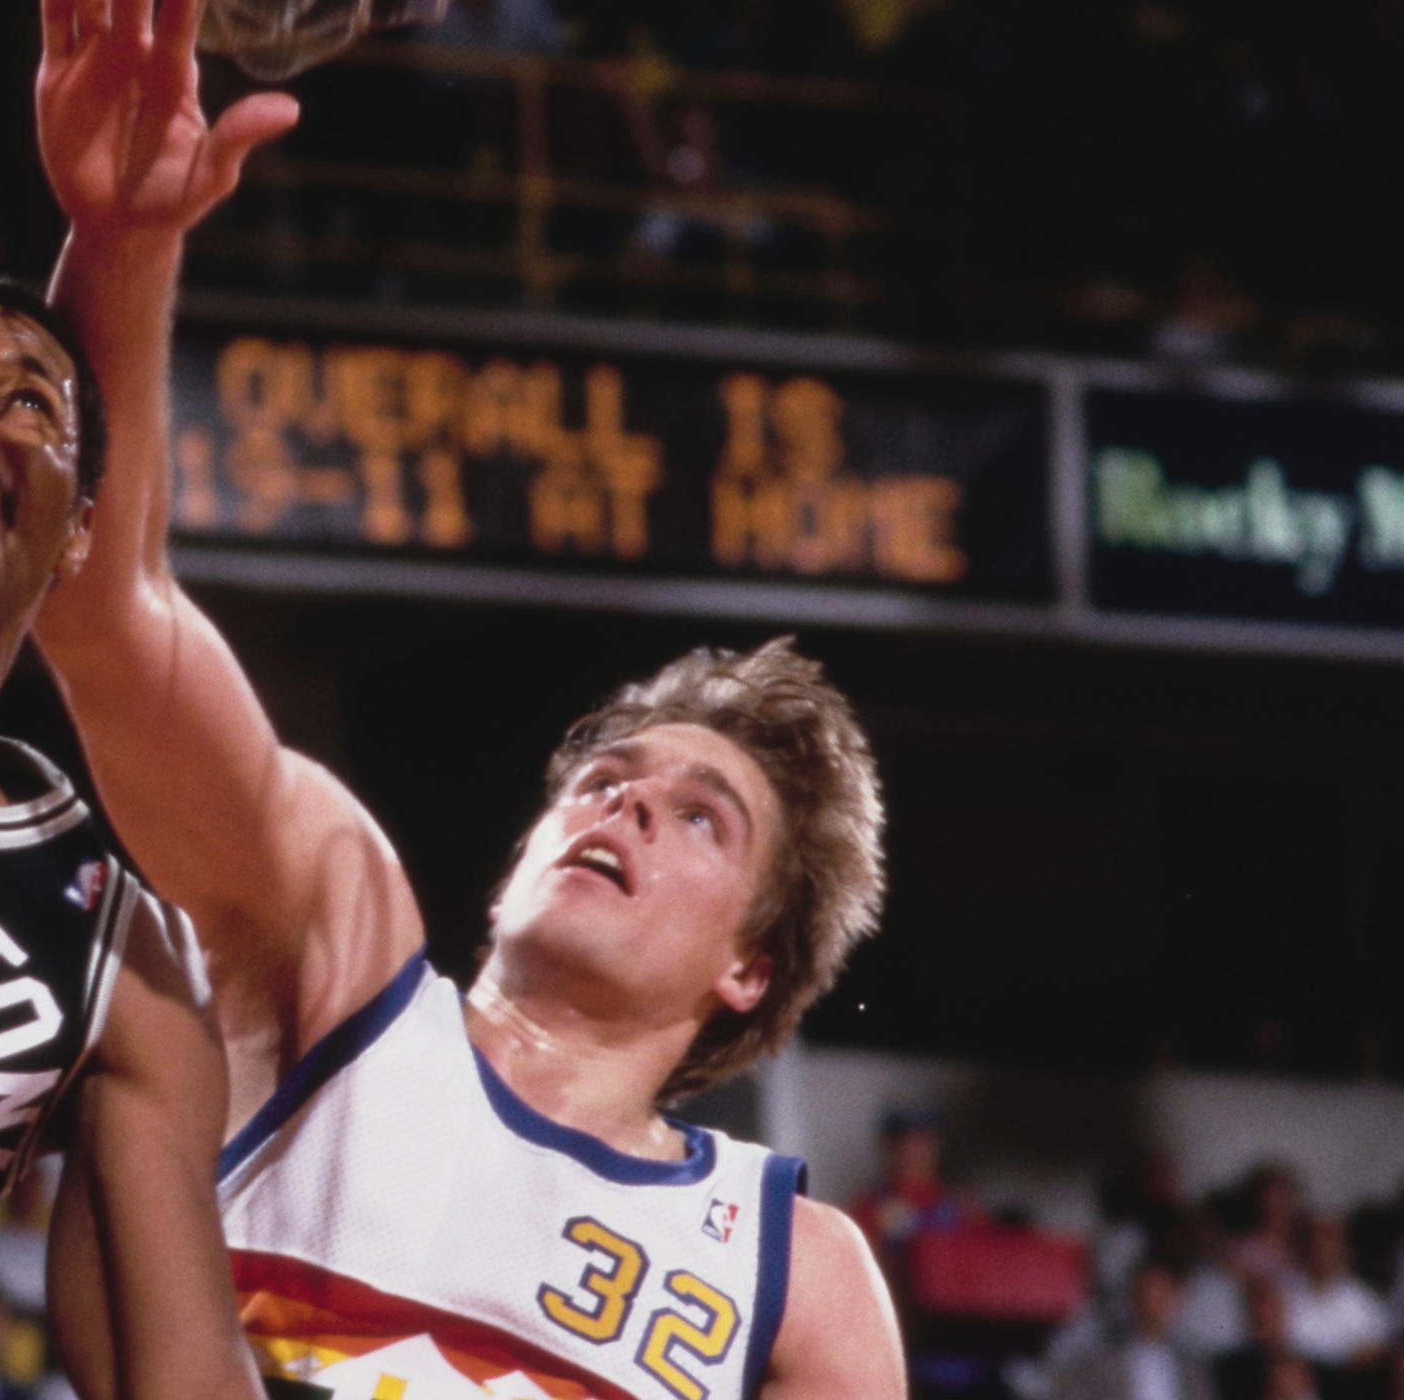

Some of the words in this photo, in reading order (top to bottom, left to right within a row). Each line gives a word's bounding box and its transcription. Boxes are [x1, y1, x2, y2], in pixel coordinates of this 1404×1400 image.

[216, 337, 653, 451] OVERALL
[529, 451, 663, 559] AT
[712, 471, 966, 582] HOME
